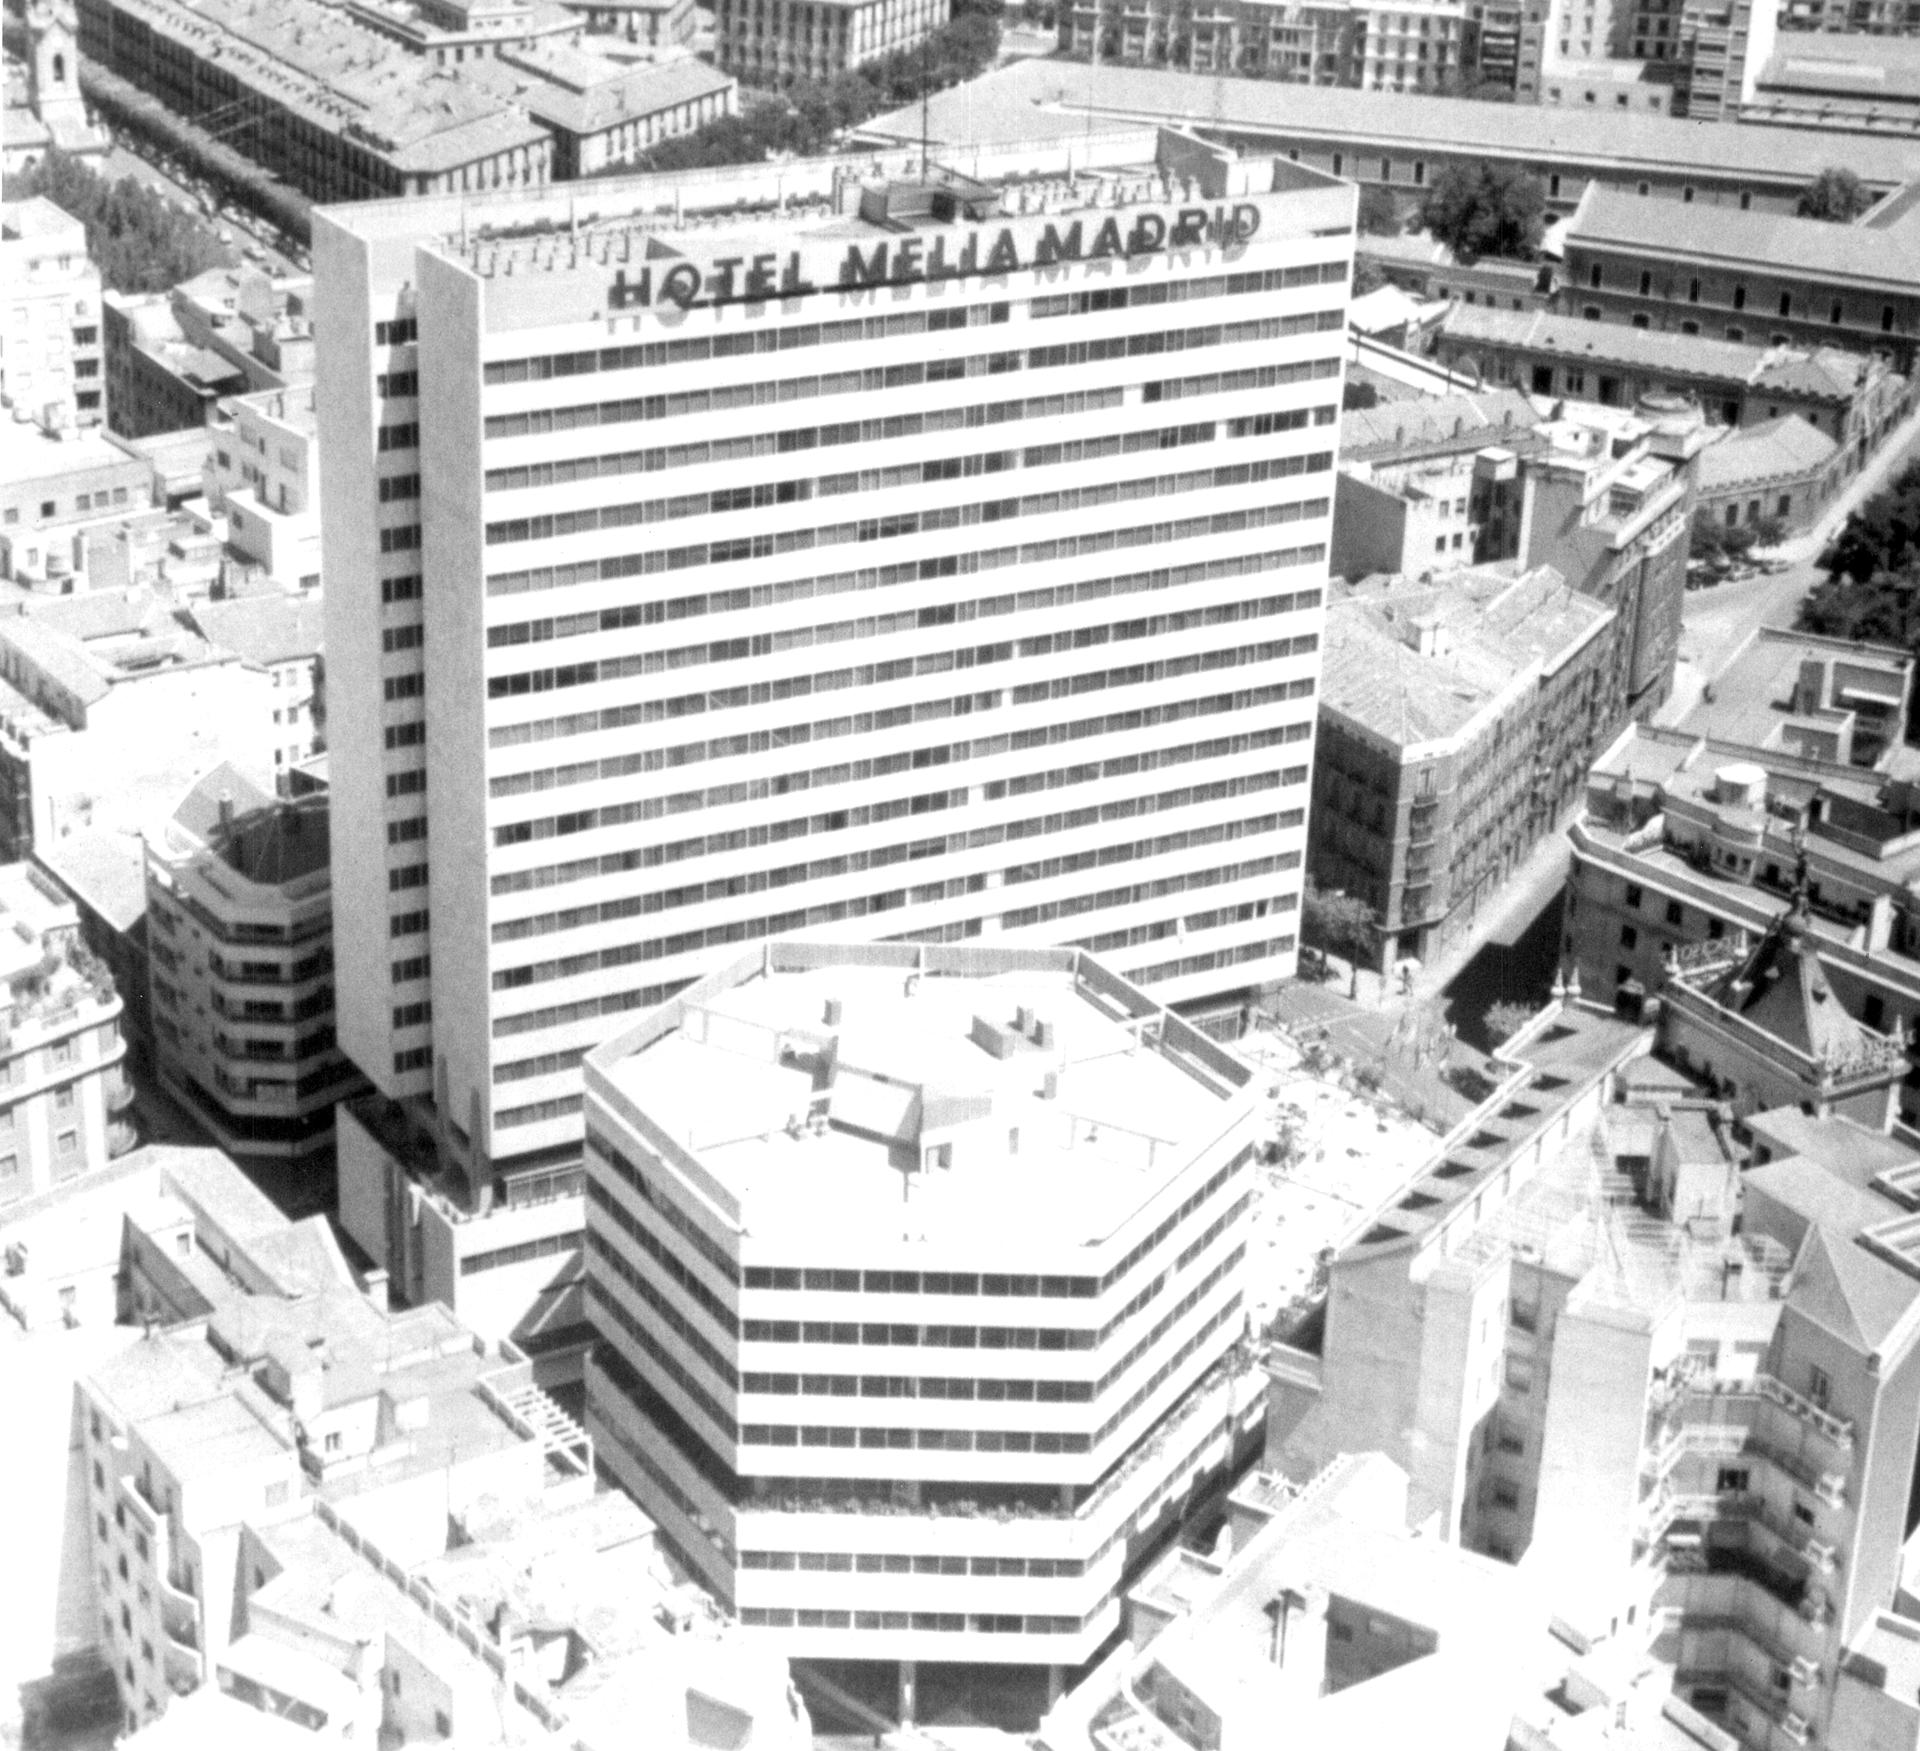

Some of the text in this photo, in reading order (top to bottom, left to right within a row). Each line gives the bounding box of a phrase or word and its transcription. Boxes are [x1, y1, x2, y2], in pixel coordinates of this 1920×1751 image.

[609, 204, 1260, 308] HOTEL MELIA MADRID
